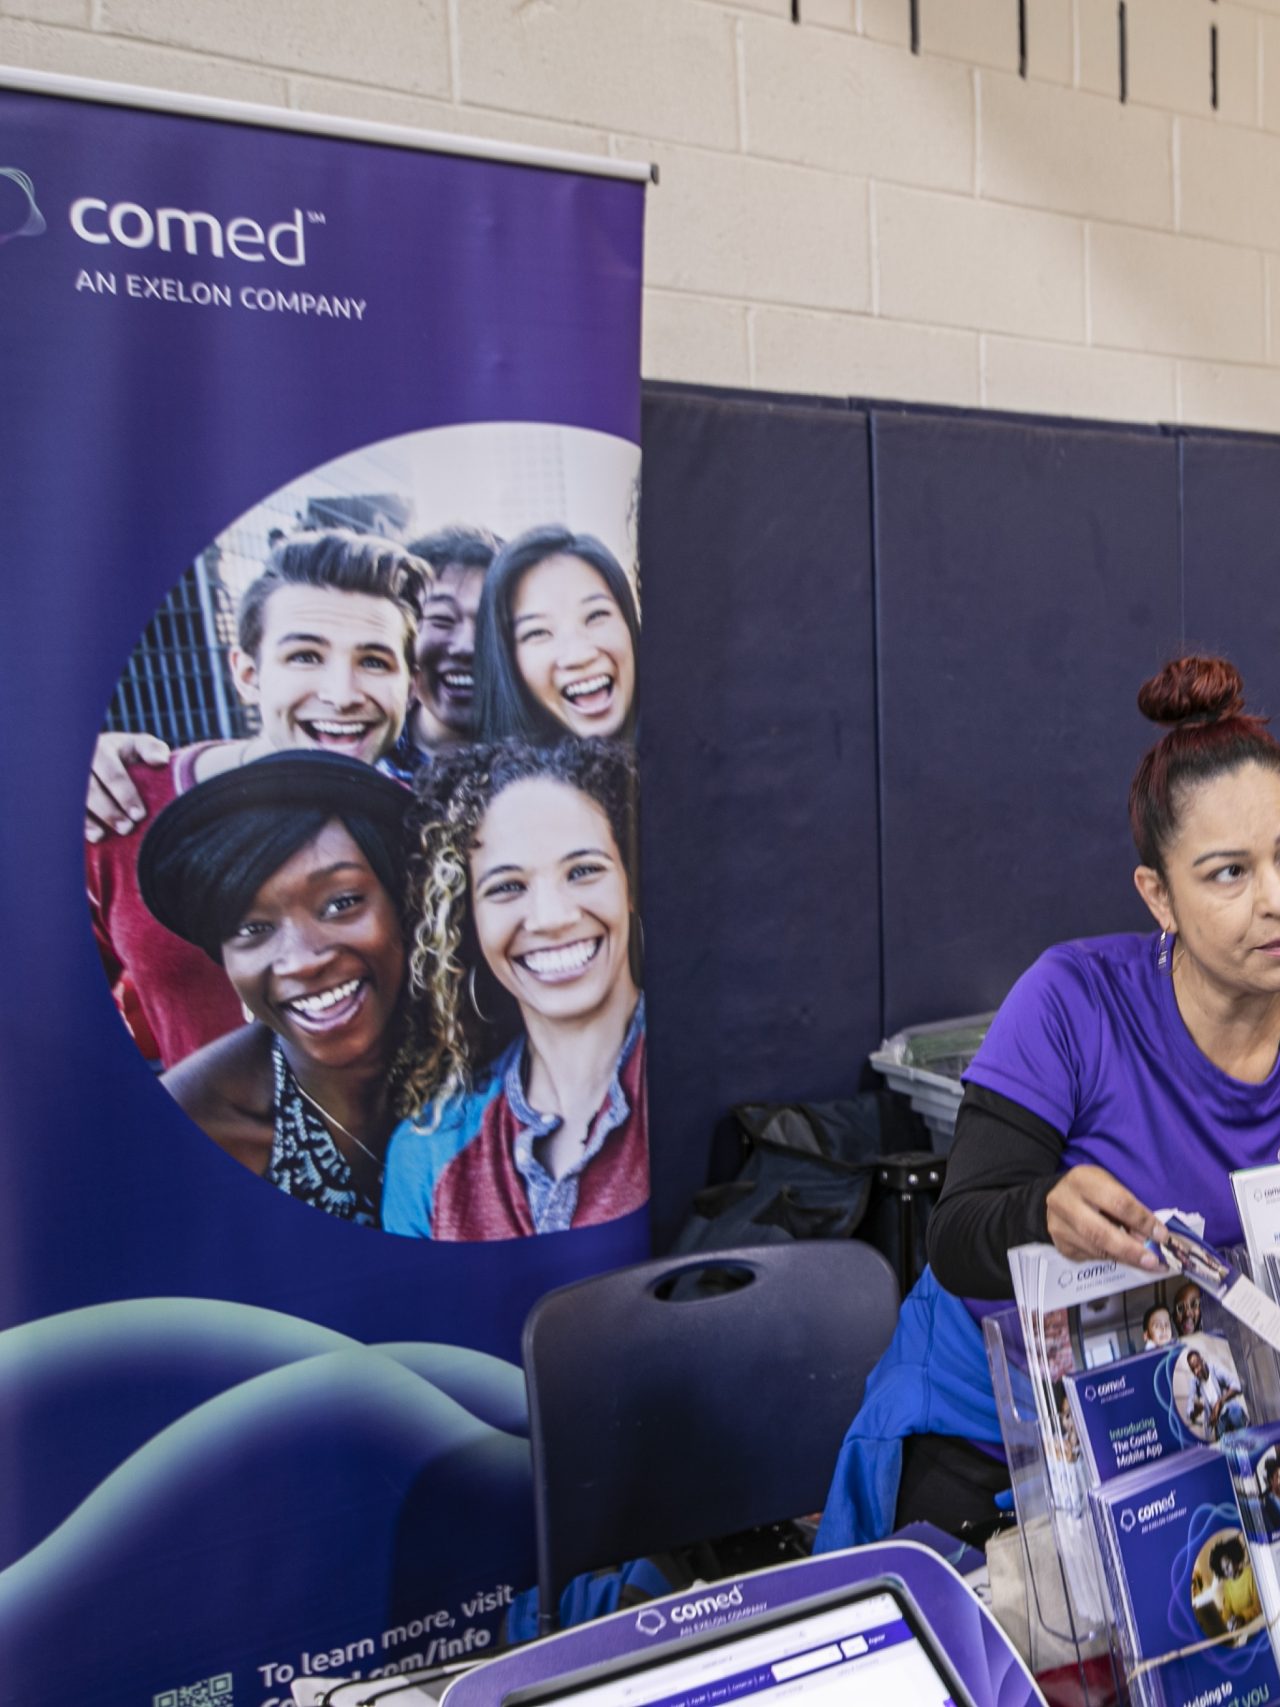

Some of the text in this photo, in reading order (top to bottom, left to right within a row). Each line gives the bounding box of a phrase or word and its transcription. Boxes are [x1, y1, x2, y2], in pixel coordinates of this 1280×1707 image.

[70, 197, 306, 266] comed
[75, 269, 367, 321] AN EXELON COMPANY
[1097, 1375, 1127, 1397] comed
[1109, 1416, 1156, 1441] Introducing
[1112, 1428, 1158, 1455] The ComEd
[1116, 1442, 1163, 1469] Mobile App
[1137, 1489, 1175, 1523] comed
[671, 1584, 743, 1623] comed
[258, 1585, 515, 1688] To learn more, visit
[1221, 1680, 1233, 1699] to
[1241, 1682, 1269, 1707] you
